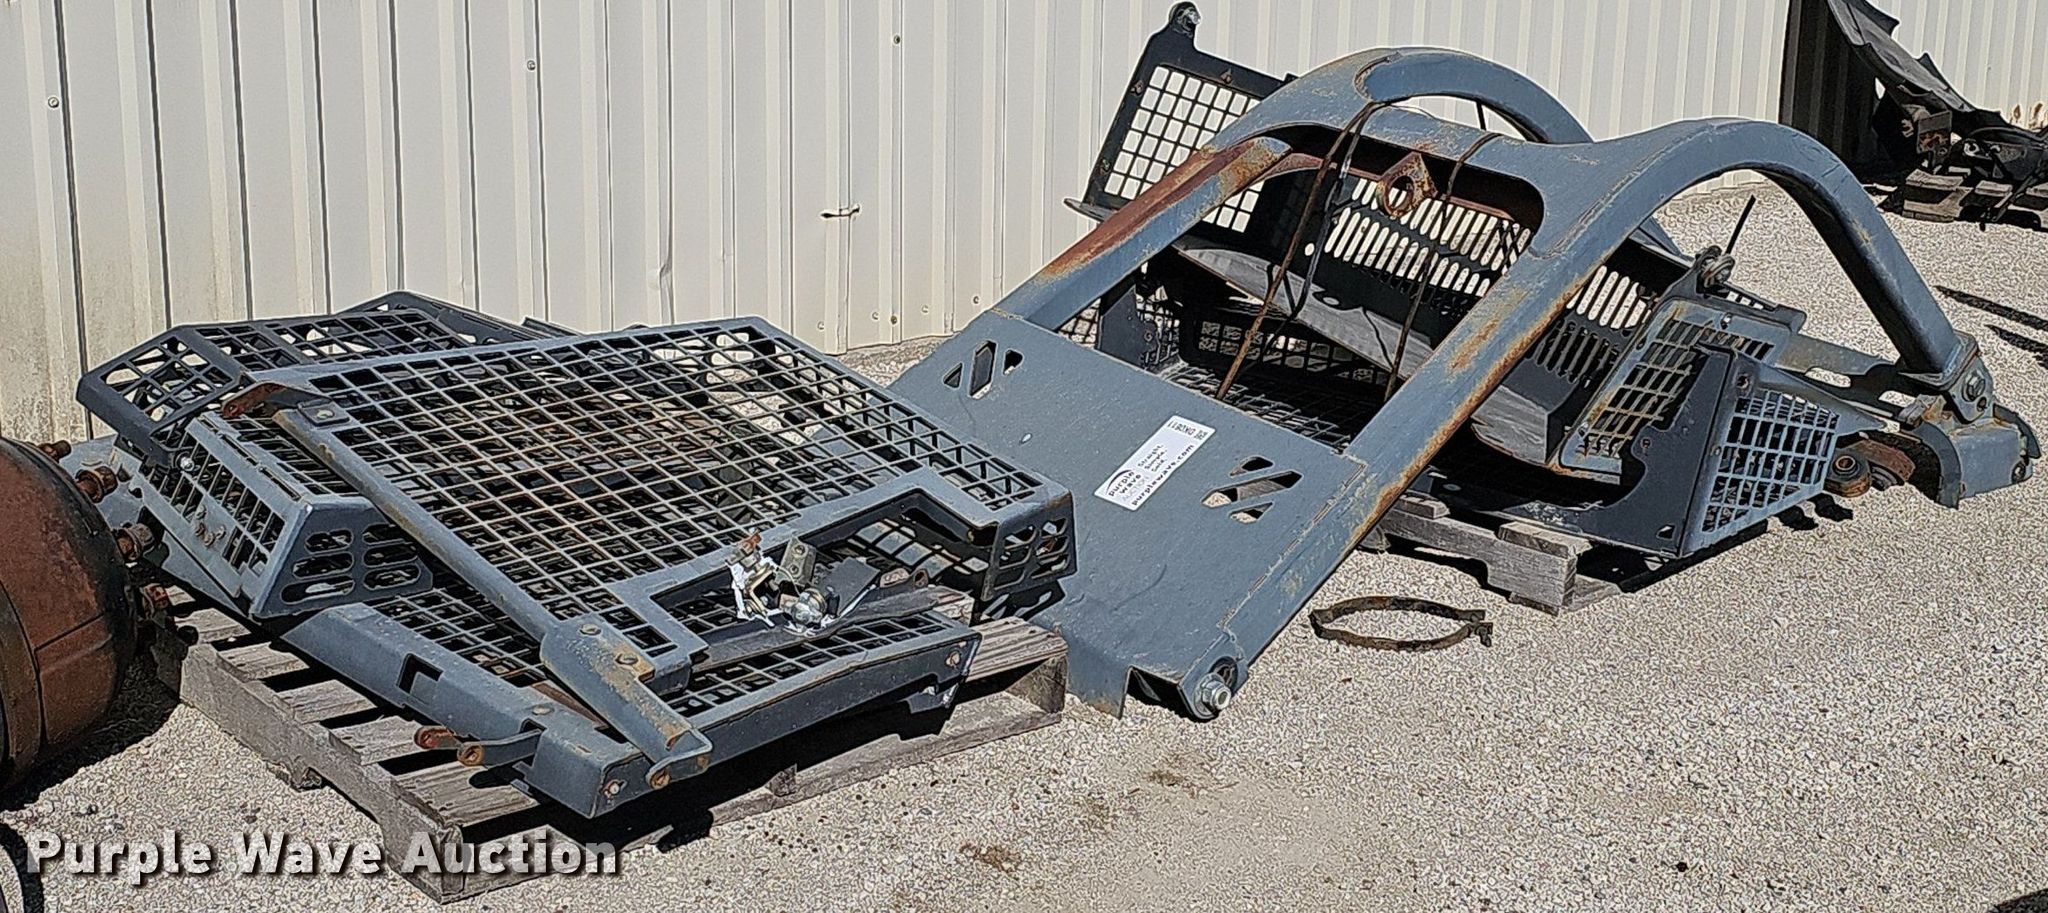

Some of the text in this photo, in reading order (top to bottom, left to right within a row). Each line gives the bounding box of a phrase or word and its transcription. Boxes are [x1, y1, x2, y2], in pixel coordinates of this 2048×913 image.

[1108, 471, 1135, 497] purple
[1120, 474, 1142, 494] wave
[1131, 444, 1195, 506] purplewave.com
